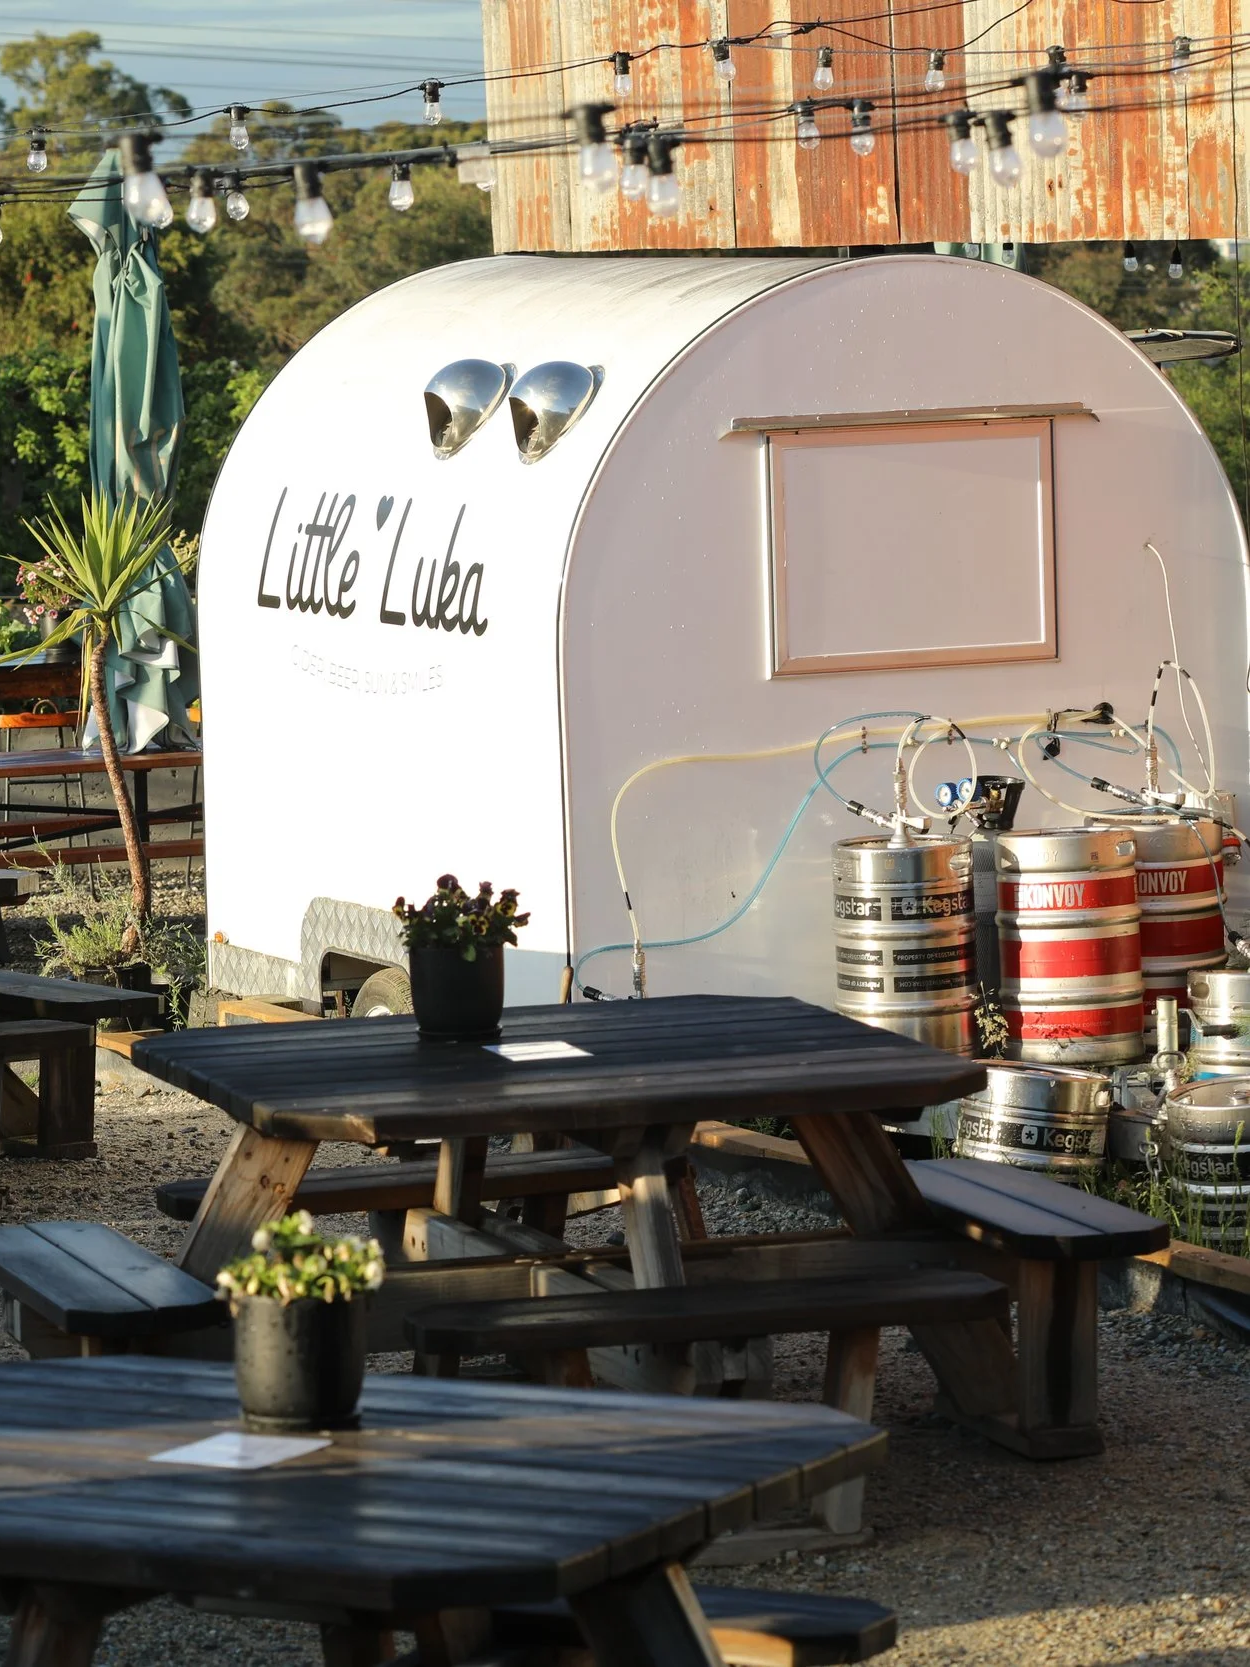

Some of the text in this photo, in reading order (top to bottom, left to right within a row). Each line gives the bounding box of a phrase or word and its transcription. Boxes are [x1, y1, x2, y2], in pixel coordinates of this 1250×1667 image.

[257, 486, 488, 637] Little Luka
[291, 644, 326, 681] CDER,
[364, 671, 388, 694] SUN
[1136, 870, 1188, 894] ONVOY
[835, 898, 872, 918] egstar
[1023, 884, 1085, 909] KONVOY
[962, 1118, 1001, 1140] egstar
